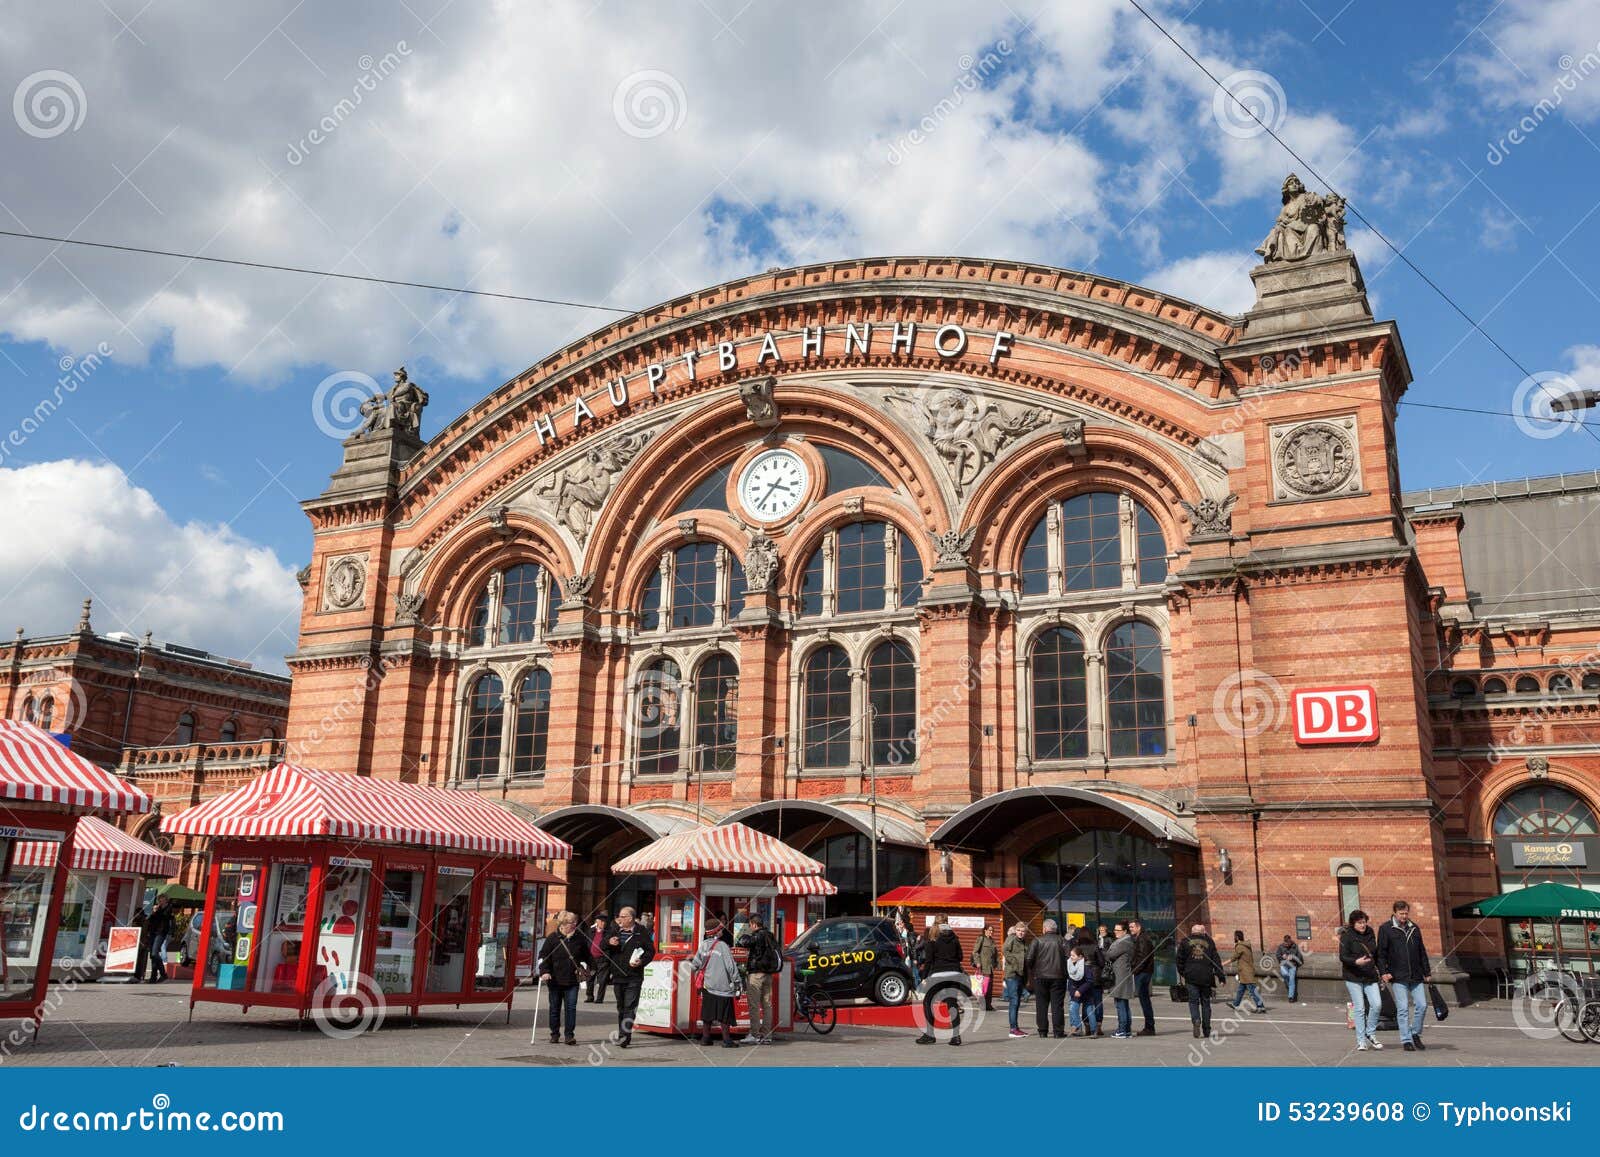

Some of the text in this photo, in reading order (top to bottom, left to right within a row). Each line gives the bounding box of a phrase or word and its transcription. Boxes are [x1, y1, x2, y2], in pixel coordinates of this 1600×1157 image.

[533, 322, 1014, 446] HAUPTBAHNHOF
[1303, 694, 1367, 734] DB
[1524, 845, 1556, 854] Kamps
[807, 950, 875, 969] fortwo
